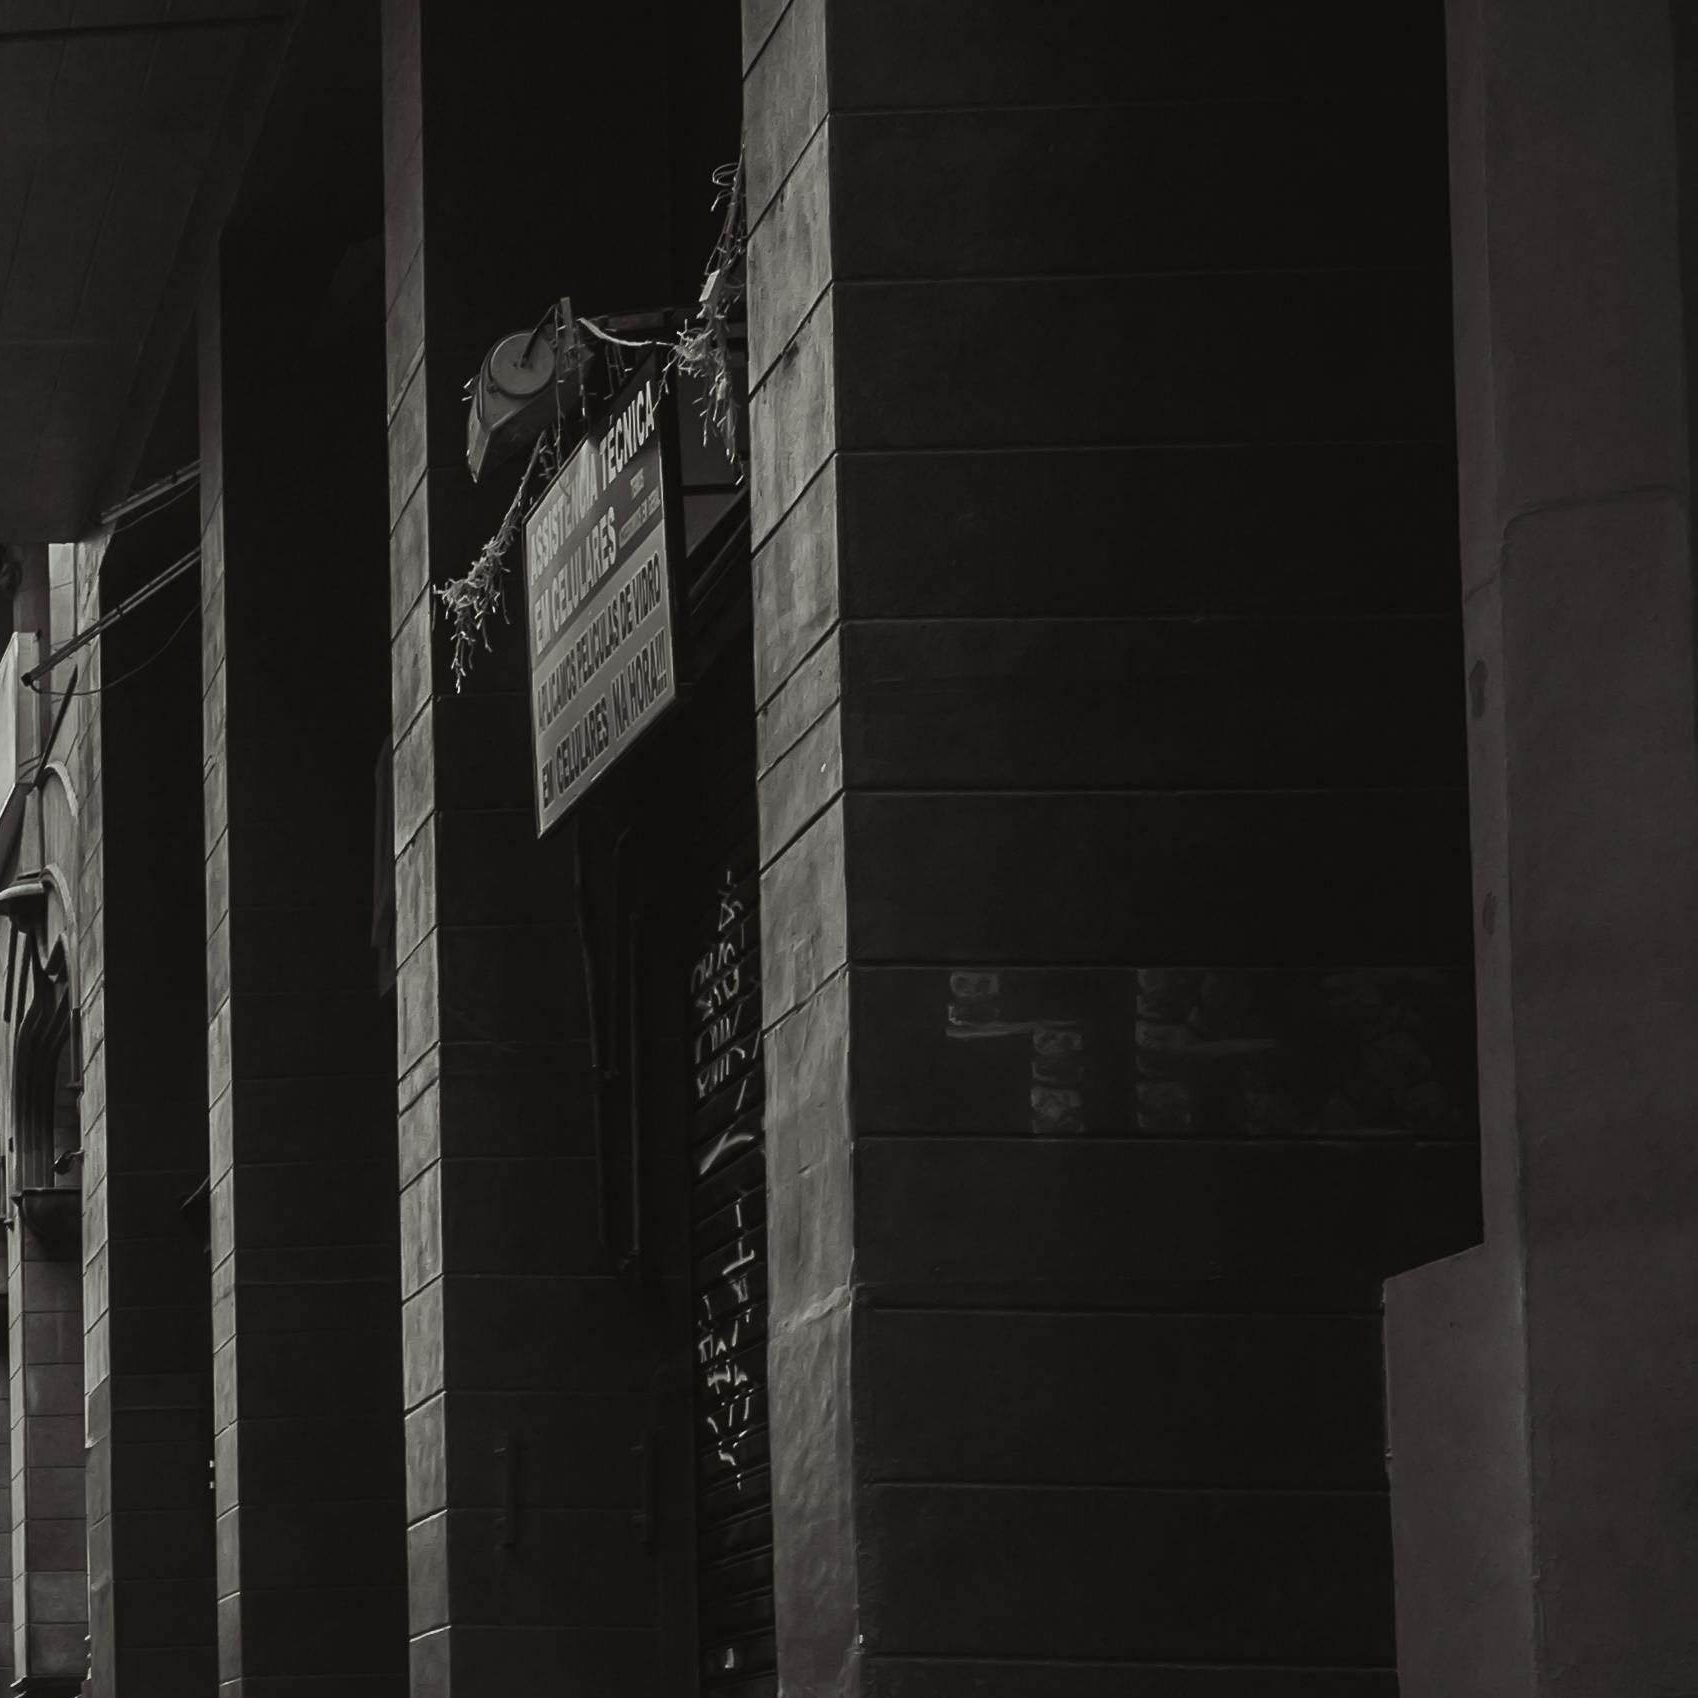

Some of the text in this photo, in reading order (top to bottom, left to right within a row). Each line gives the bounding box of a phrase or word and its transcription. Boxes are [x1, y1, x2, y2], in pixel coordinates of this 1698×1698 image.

[599, 380, 655, 491] TÉCNICA
[535, 506, 616, 656] EM CELULARES
[619, 584, 633, 641] DE
[632, 553, 661, 626] VIDRO
[542, 760, 555, 808] EM
[556, 696, 609, 795] CELULARES
[611, 672, 630, 739] NA
